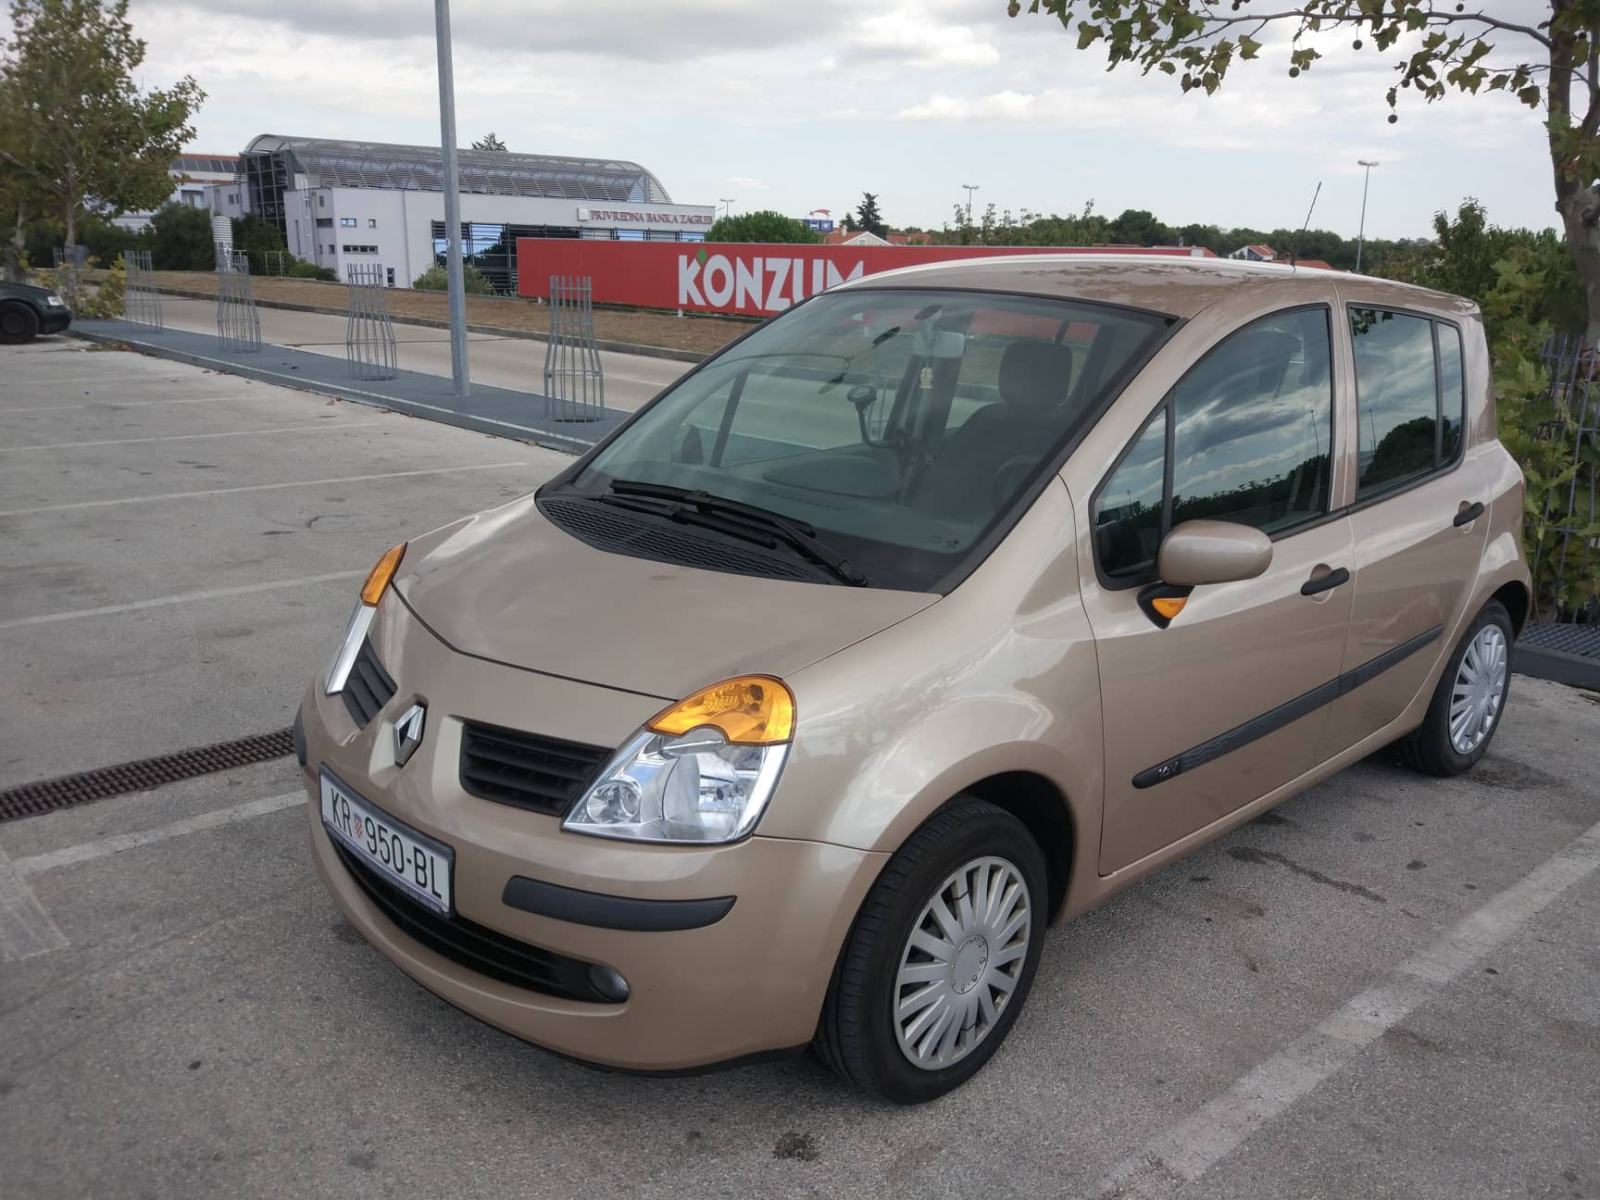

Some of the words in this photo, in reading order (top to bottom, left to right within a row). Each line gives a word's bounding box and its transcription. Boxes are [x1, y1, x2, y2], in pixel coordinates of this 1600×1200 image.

[590, 210, 645, 222] PRIVREDNA
[646, 213, 679, 224] BANKA
[680, 214, 714, 225] ZAGREB
[331, 788, 353, 838] KR
